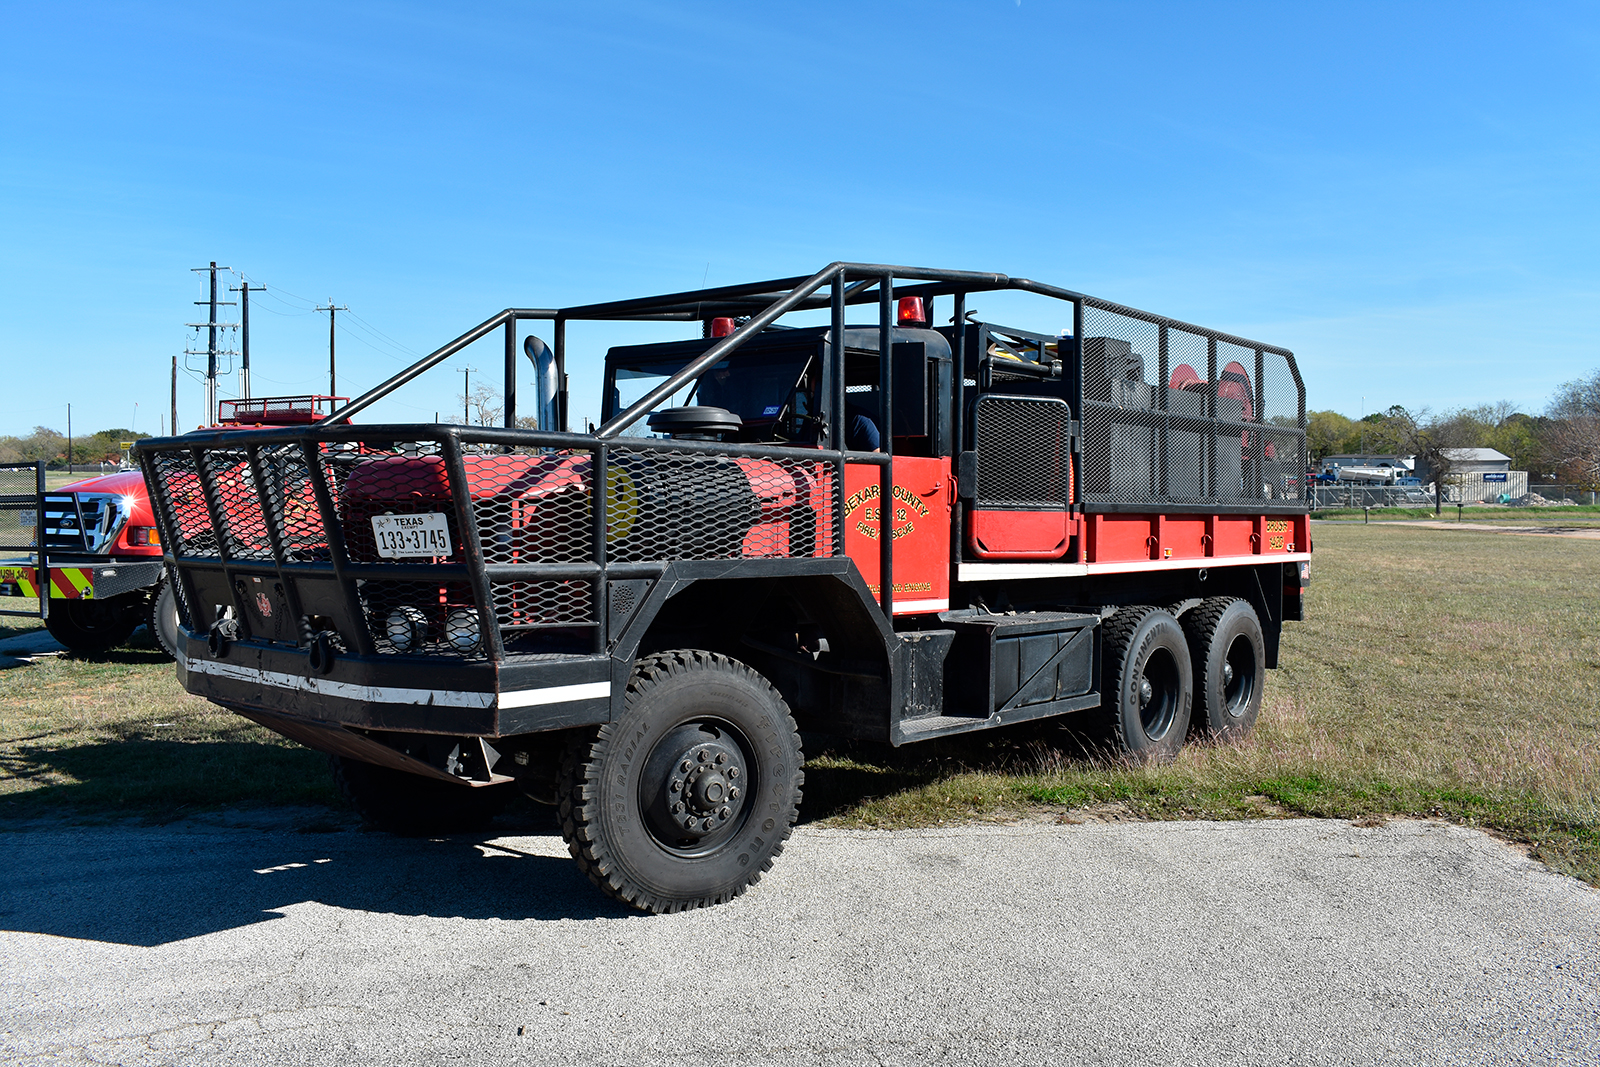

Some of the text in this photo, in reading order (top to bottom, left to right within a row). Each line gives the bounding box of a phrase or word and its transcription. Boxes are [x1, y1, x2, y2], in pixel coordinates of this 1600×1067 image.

[844, 484, 930, 518] BEXAR OUNTY
[896, 507, 907, 521] 12
[394, 517, 424, 526] TEXAS
[0, 568, 15, 580] USH
[904, 581, 932, 593] ENGINE
[616, 722, 650, 787] RADIAL
